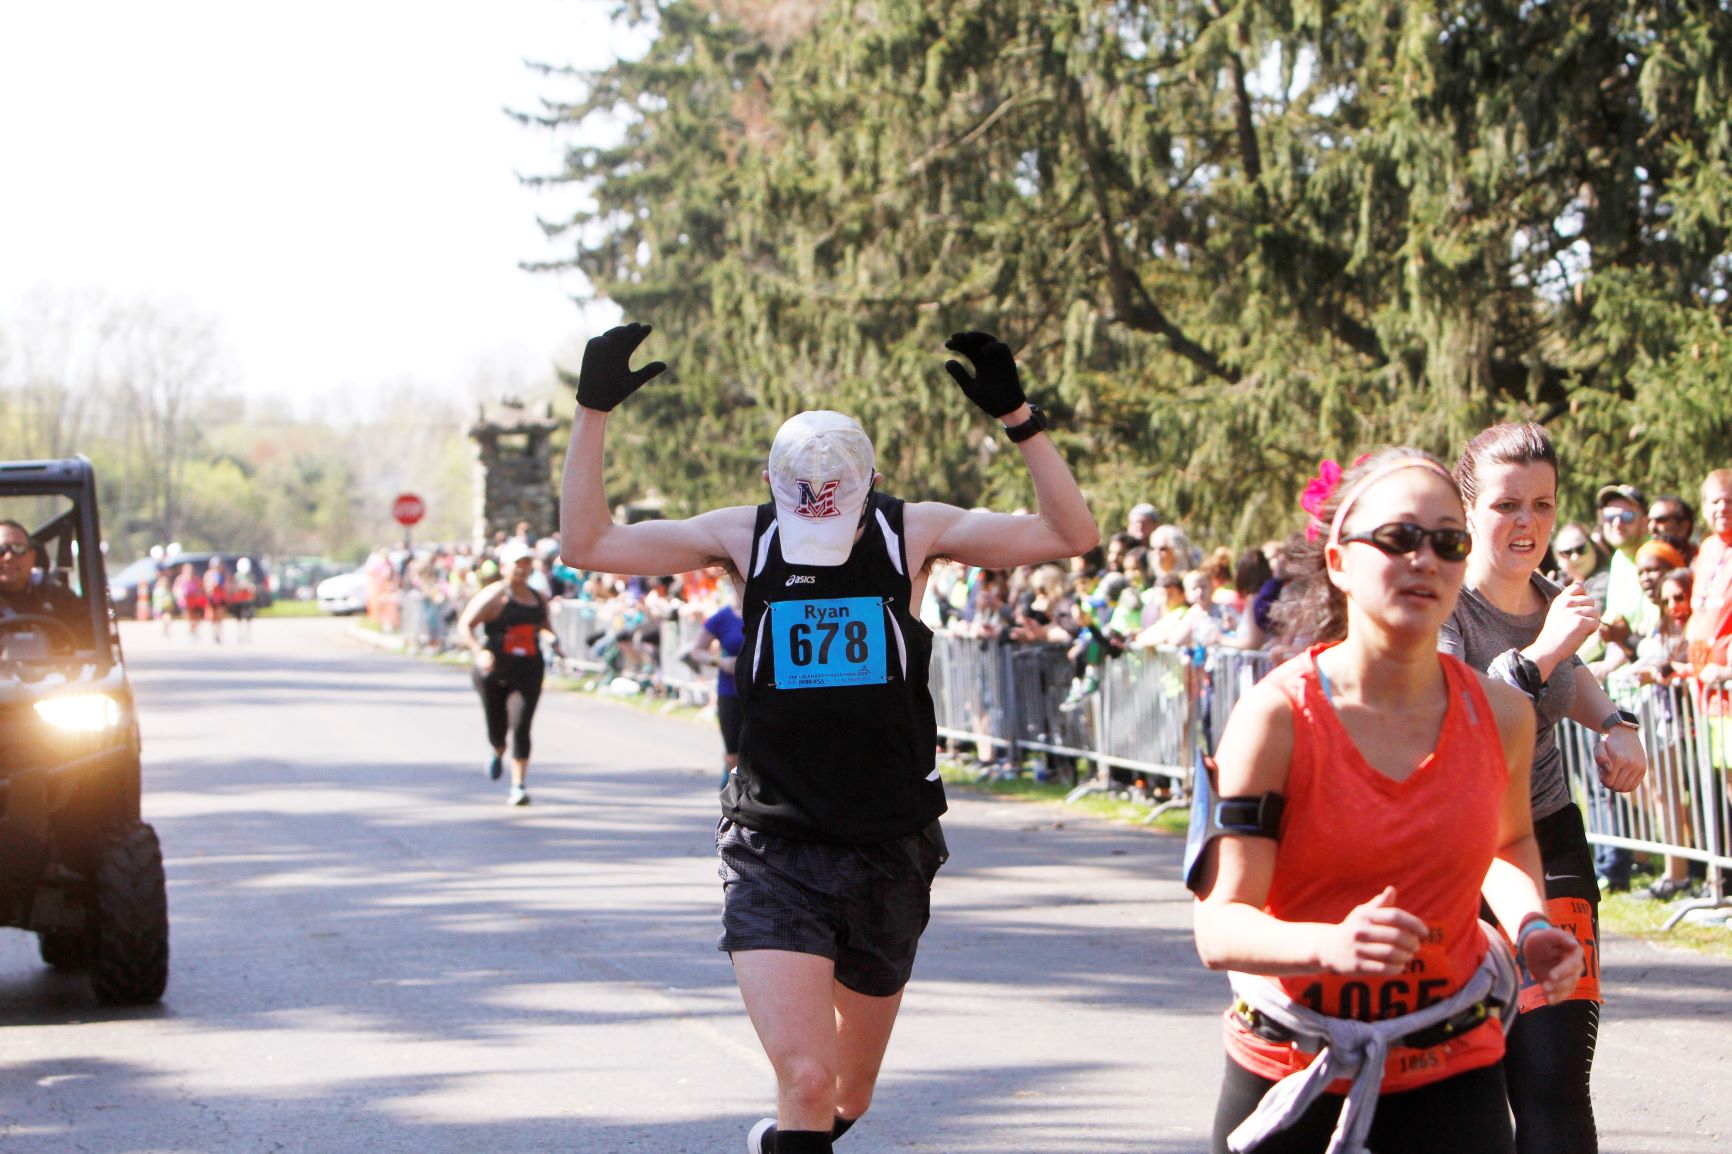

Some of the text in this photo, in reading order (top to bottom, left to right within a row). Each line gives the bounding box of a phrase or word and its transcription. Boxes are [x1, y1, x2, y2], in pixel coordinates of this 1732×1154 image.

[795, 479, 841, 518] M
[804, 604, 850, 624] Ryan
[789, 620, 869, 667] 678
